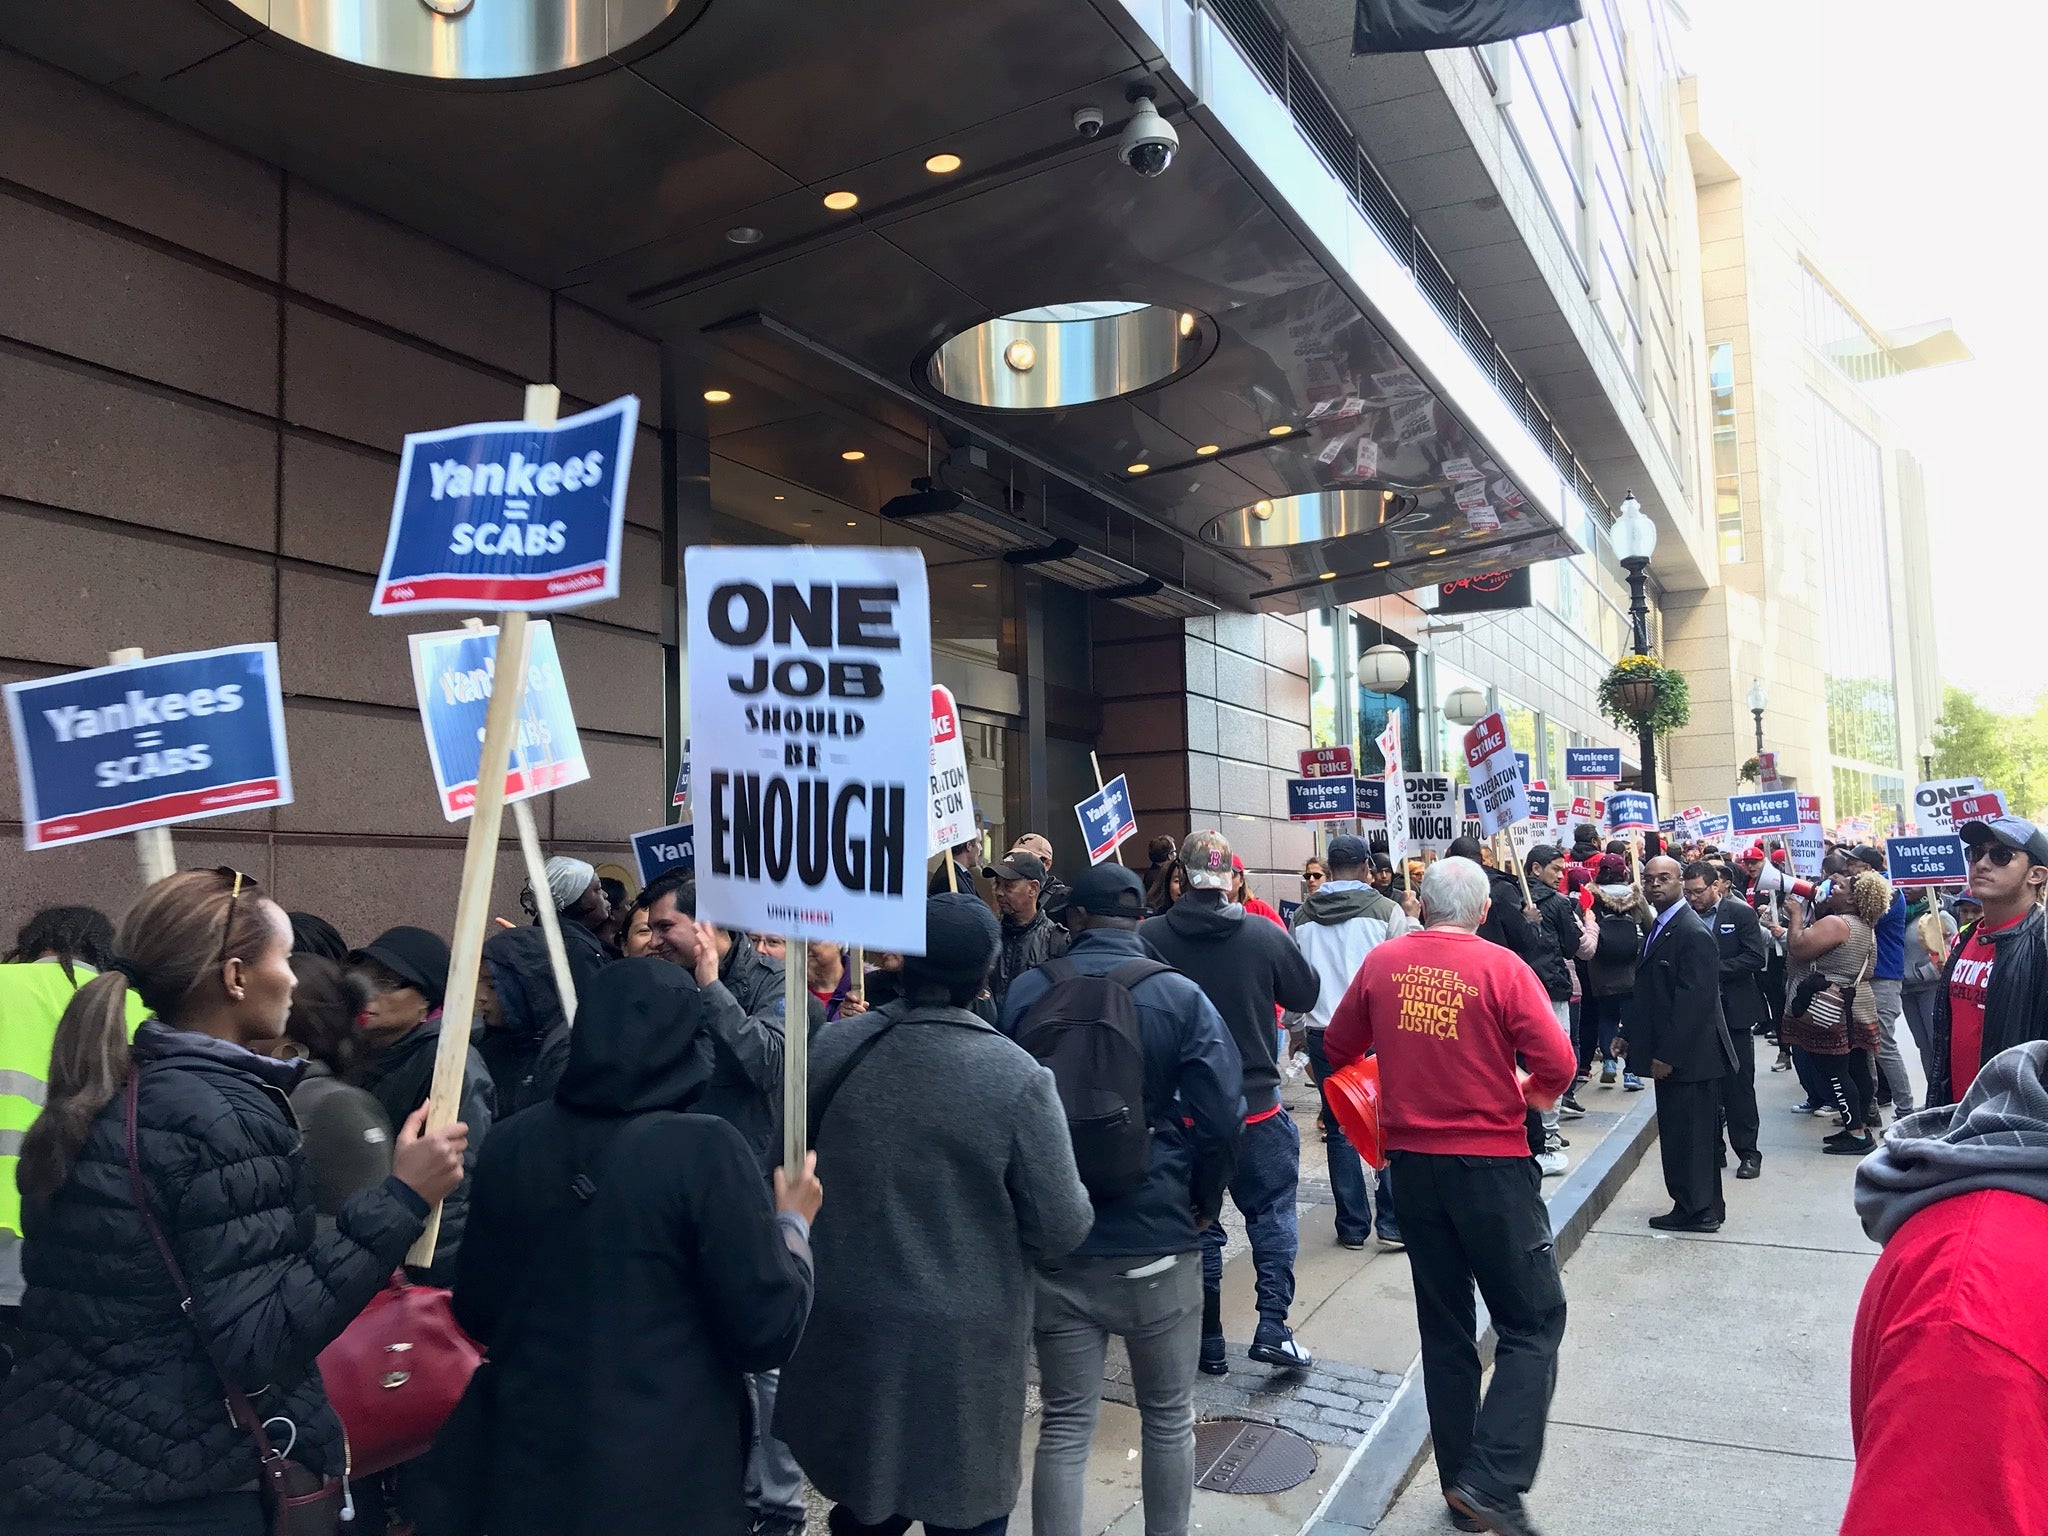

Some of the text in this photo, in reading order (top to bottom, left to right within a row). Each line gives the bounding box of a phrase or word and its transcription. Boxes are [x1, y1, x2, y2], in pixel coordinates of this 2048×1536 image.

[430, 449, 604, 501] Yankees
[450, 521, 567, 556] SCABS
[707, 581, 901, 650] ONE
[728, 655, 885, 698] JOB
[45, 683, 243, 744] Yankees
[744, 703, 865, 741] SHOULD
[1475, 722, 1489, 739] ON
[784, 740, 821, 770] BE
[1317, 750, 1335, 761] ON
[1470, 732, 1502, 762] STRIKE
[1572, 753, 1615, 761] Yankees
[96, 743, 213, 789] SCABS
[1307, 761, 1348, 775] SRIKE
[1295, 785, 1347, 796] Yankees
[1403, 778, 1449, 792] ONE
[1475, 766, 1517, 800] SHERATON
[1307, 800, 1338, 810] SCABS
[1407, 792, 1446, 802] JOB
[1484, 785, 1516, 813] BOSTON
[1086, 791, 1123, 823] Yankees
[1574, 806, 1601, 818] STRE
[1738, 800, 1790, 812] Yankees
[1928, 806, 1952, 818] JO
[1962, 800, 1979, 814] ON
[1751, 815, 1782, 825] SCABS
[1799, 810, 1820, 820] RIKE
[1954, 812, 1997, 828] SKE
[710, 769, 906, 897] ENOUGH
[1409, 816, 1452, 840] NOUGH
[1530, 822, 1548, 830] ATON
[1531, 829, 1545, 837] TON
[1791, 848, 1816, 858] BOSTON
[1896, 844, 1954, 857] Yankees
[1911, 862, 1946, 873] SCABS
[1407, 964, 1463, 982] HOTEL
[1391, 973, 1479, 997] WORKERS
[1397, 983, 1464, 1009] JUSTICIA
[1400, 999, 1458, 1024] JUSTICE
[1397, 1015, 1459, 1040] JUSTIÇA
